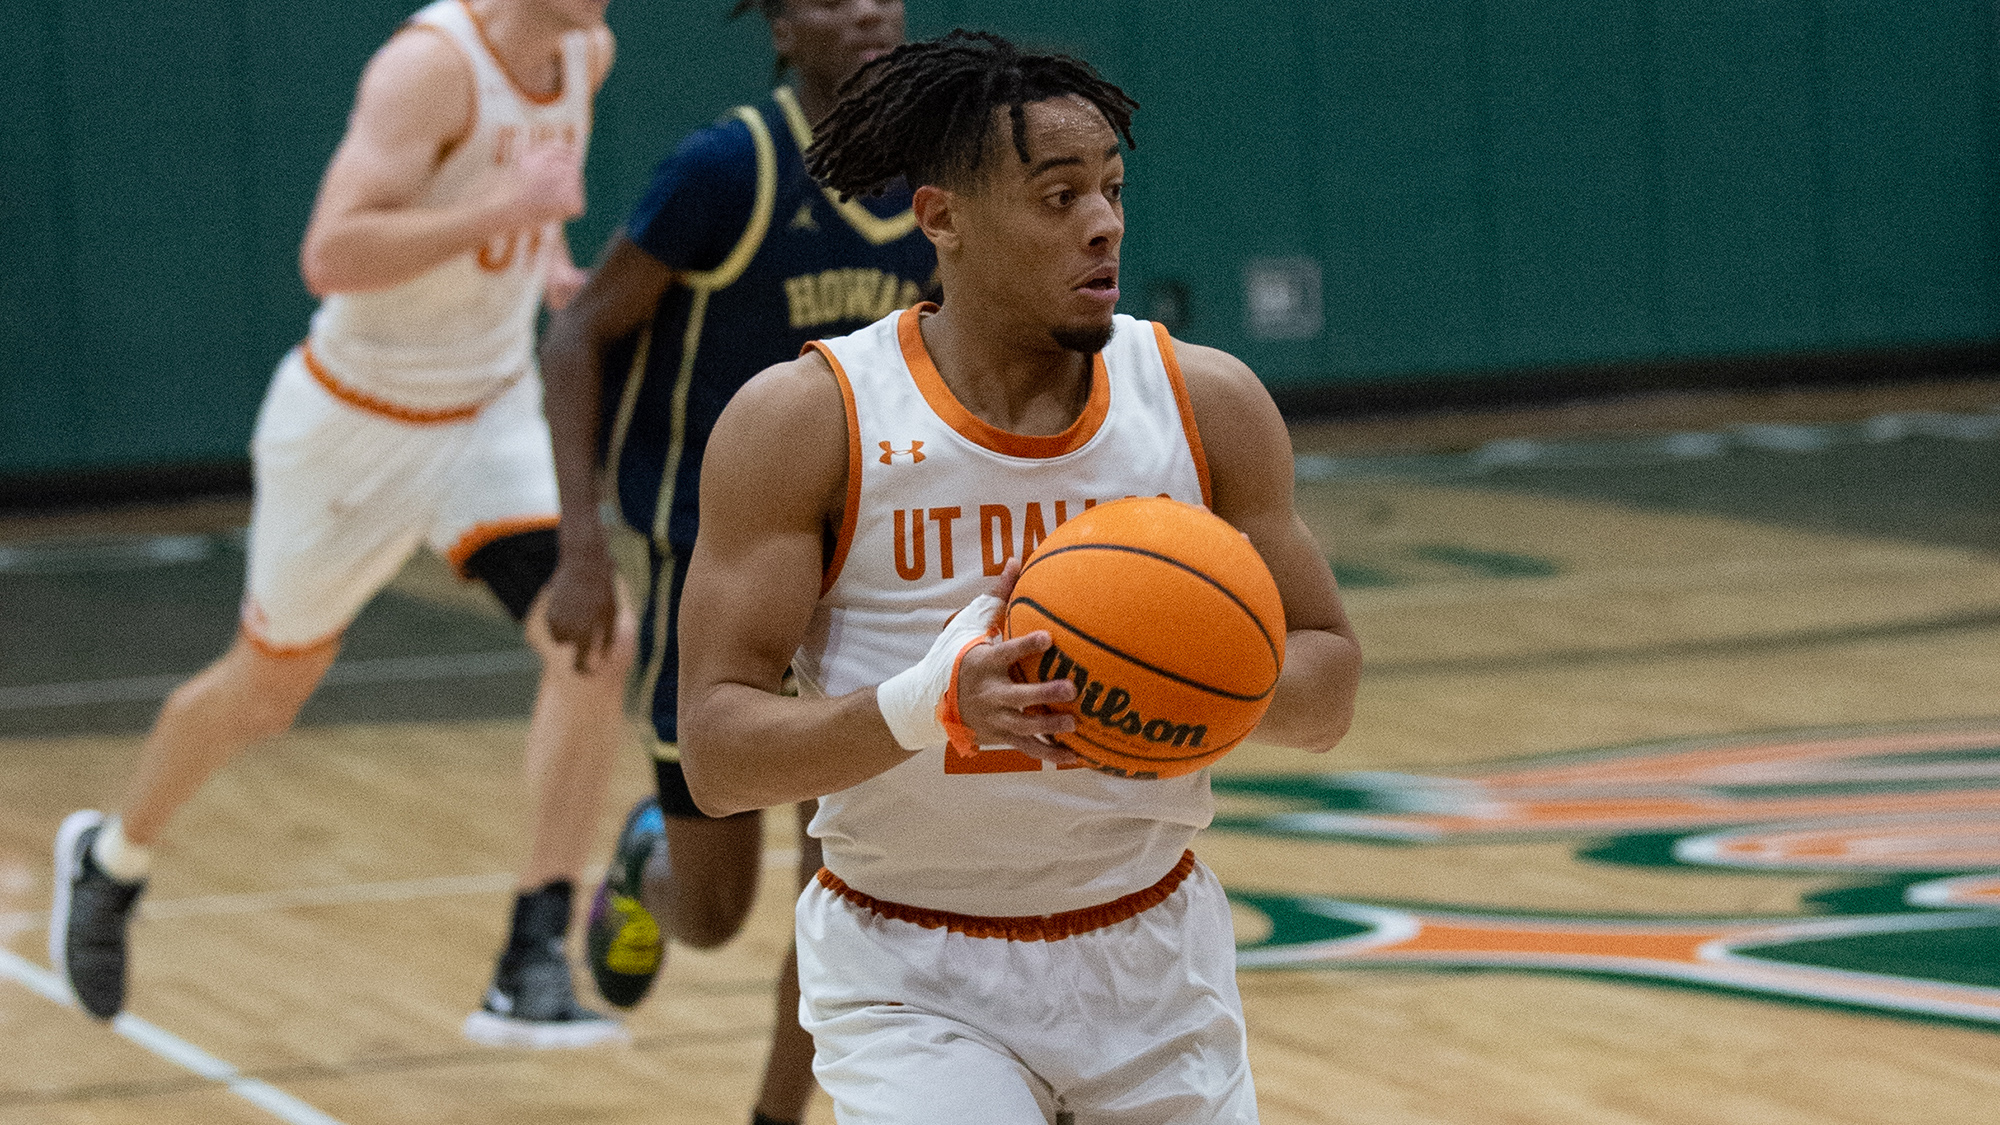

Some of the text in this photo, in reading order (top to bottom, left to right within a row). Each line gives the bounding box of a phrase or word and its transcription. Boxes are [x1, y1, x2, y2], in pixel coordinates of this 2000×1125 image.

[784, 266, 922, 328] HOWA
[893, 506, 961, 581] UT
[1038, 644, 1208, 748] Wilson
